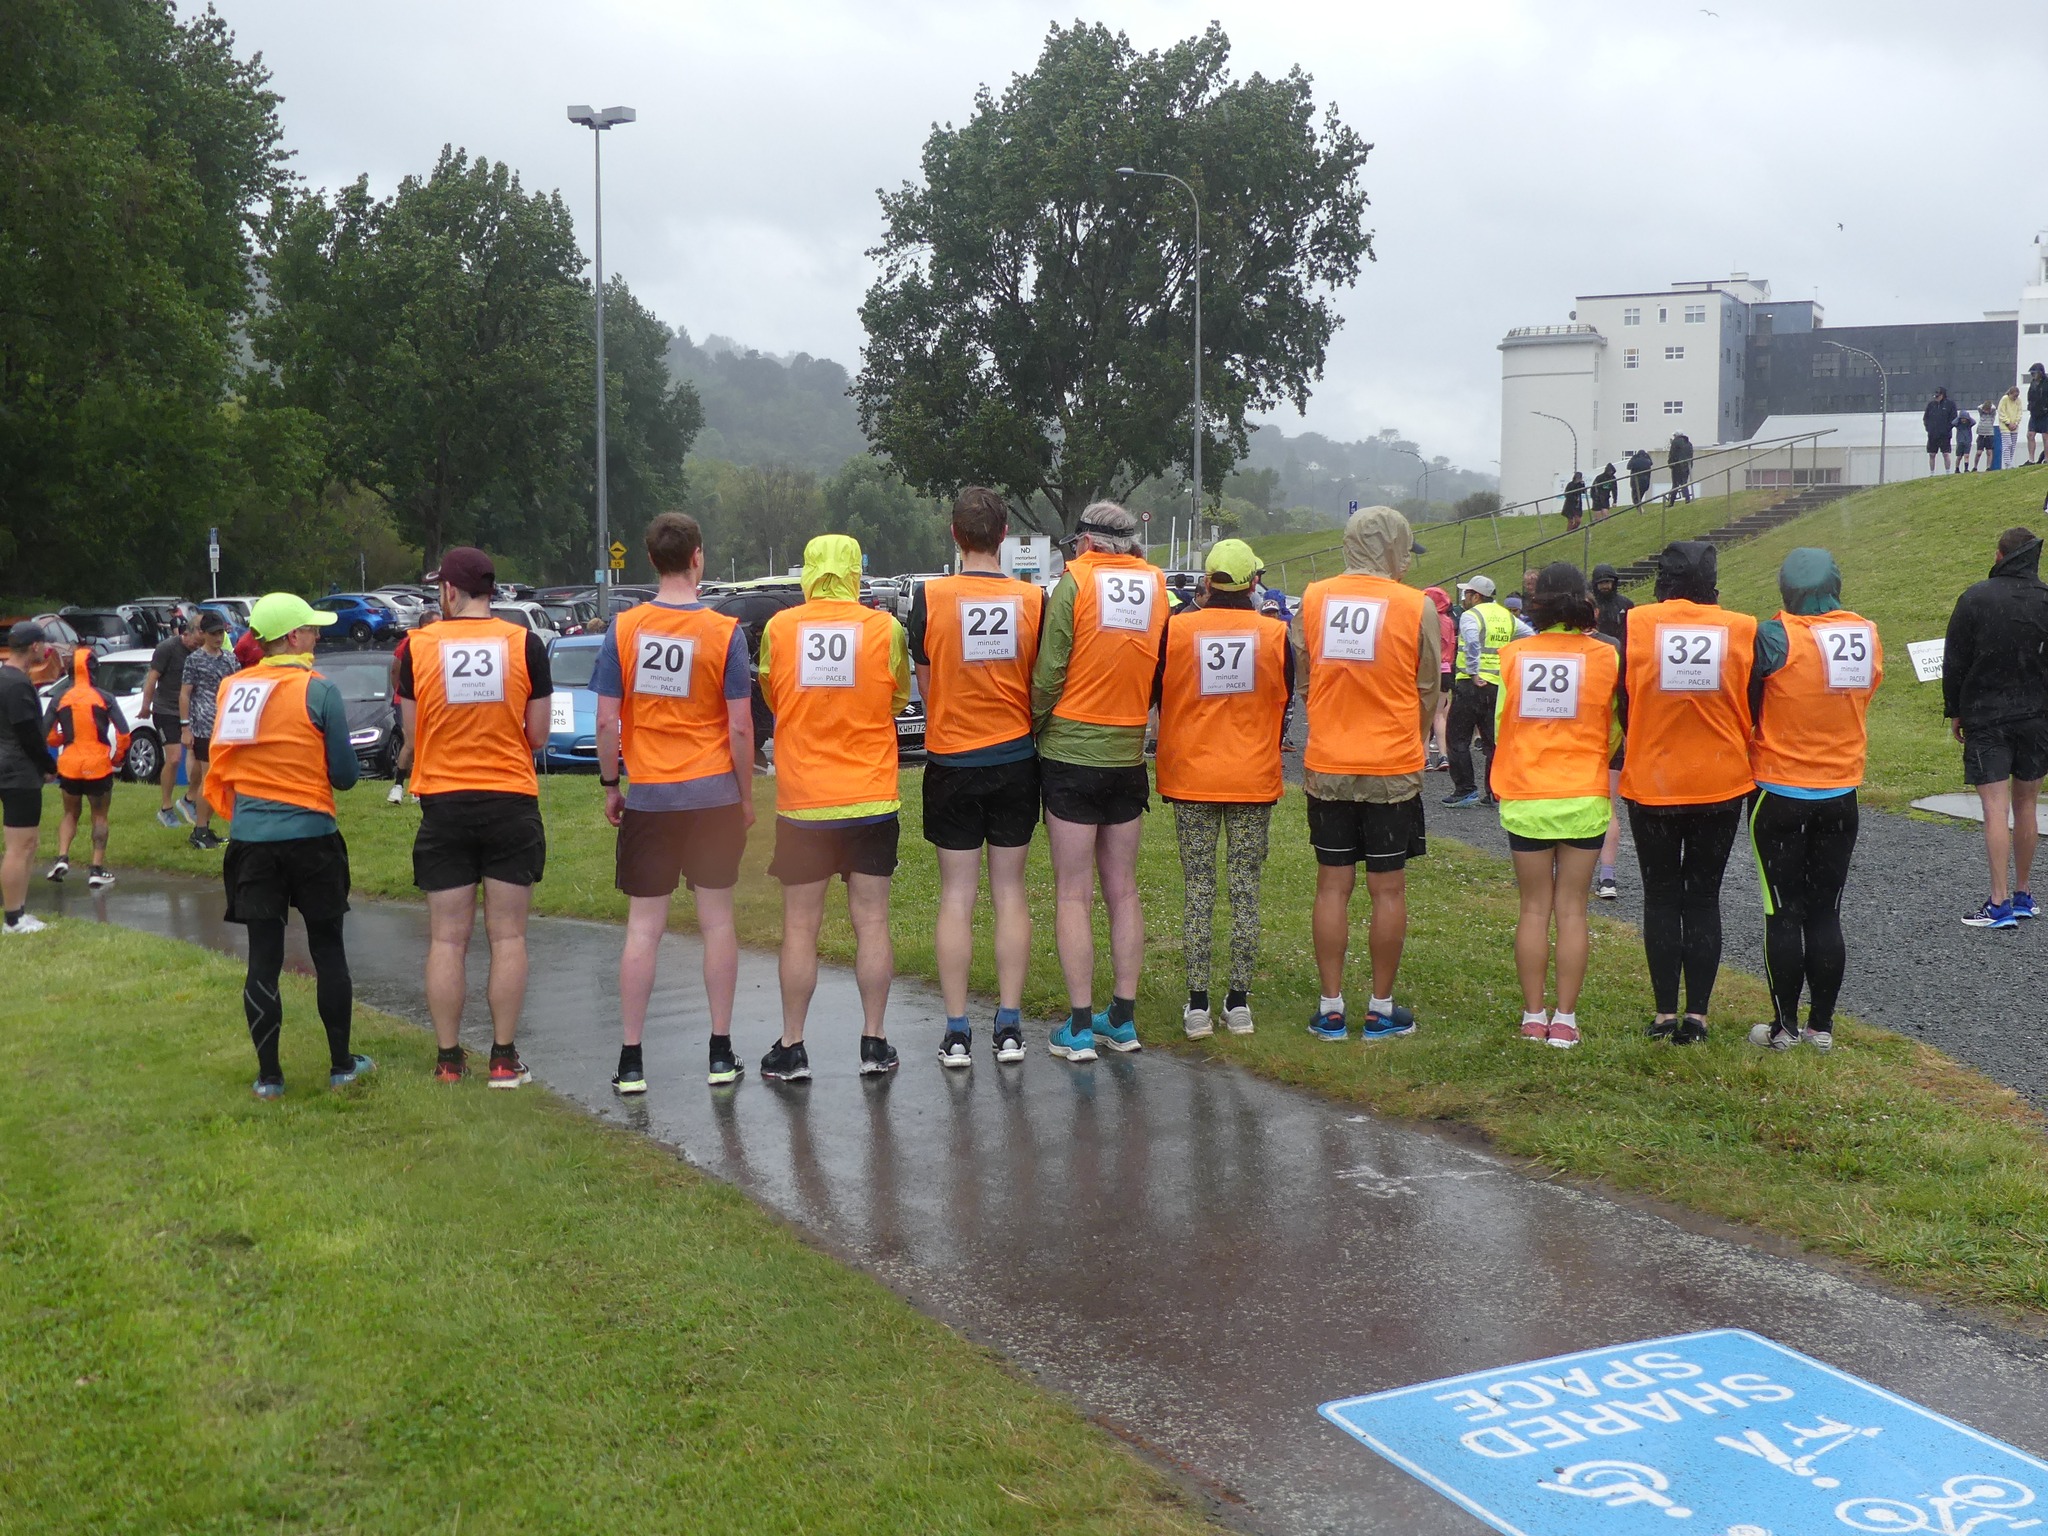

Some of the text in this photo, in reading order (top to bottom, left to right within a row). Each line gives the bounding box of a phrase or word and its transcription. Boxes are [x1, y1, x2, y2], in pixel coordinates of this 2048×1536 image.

[1107, 577, 1145, 605] 35
[968, 606, 1008, 636] 22
[1116, 607, 1136, 615] minute
[1125, 617, 1143, 626] PACER
[1329, 606, 1370, 635] 40
[642, 641, 684, 673] 20
[807, 633, 847, 662] 30
[1206, 642, 1246, 671] 37
[1667, 635, 1711, 665] 32
[1828, 633, 1866, 662] 25
[1921, 656, 1944, 665] CAUT
[451, 649, 493, 678] 23
[650, 674, 674, 683] minute
[660, 684, 682, 692] PACER
[1526, 663, 1569, 694] 28
[227, 686, 261, 714] 26
[551, 709, 564, 717] ON
[1535, 696, 1560, 704] minute
[898, 724, 926, 733] KWH772
[1434, 1352, 1703, 1423] SPACE
[1460, 1373, 1796, 1459] SHARED
